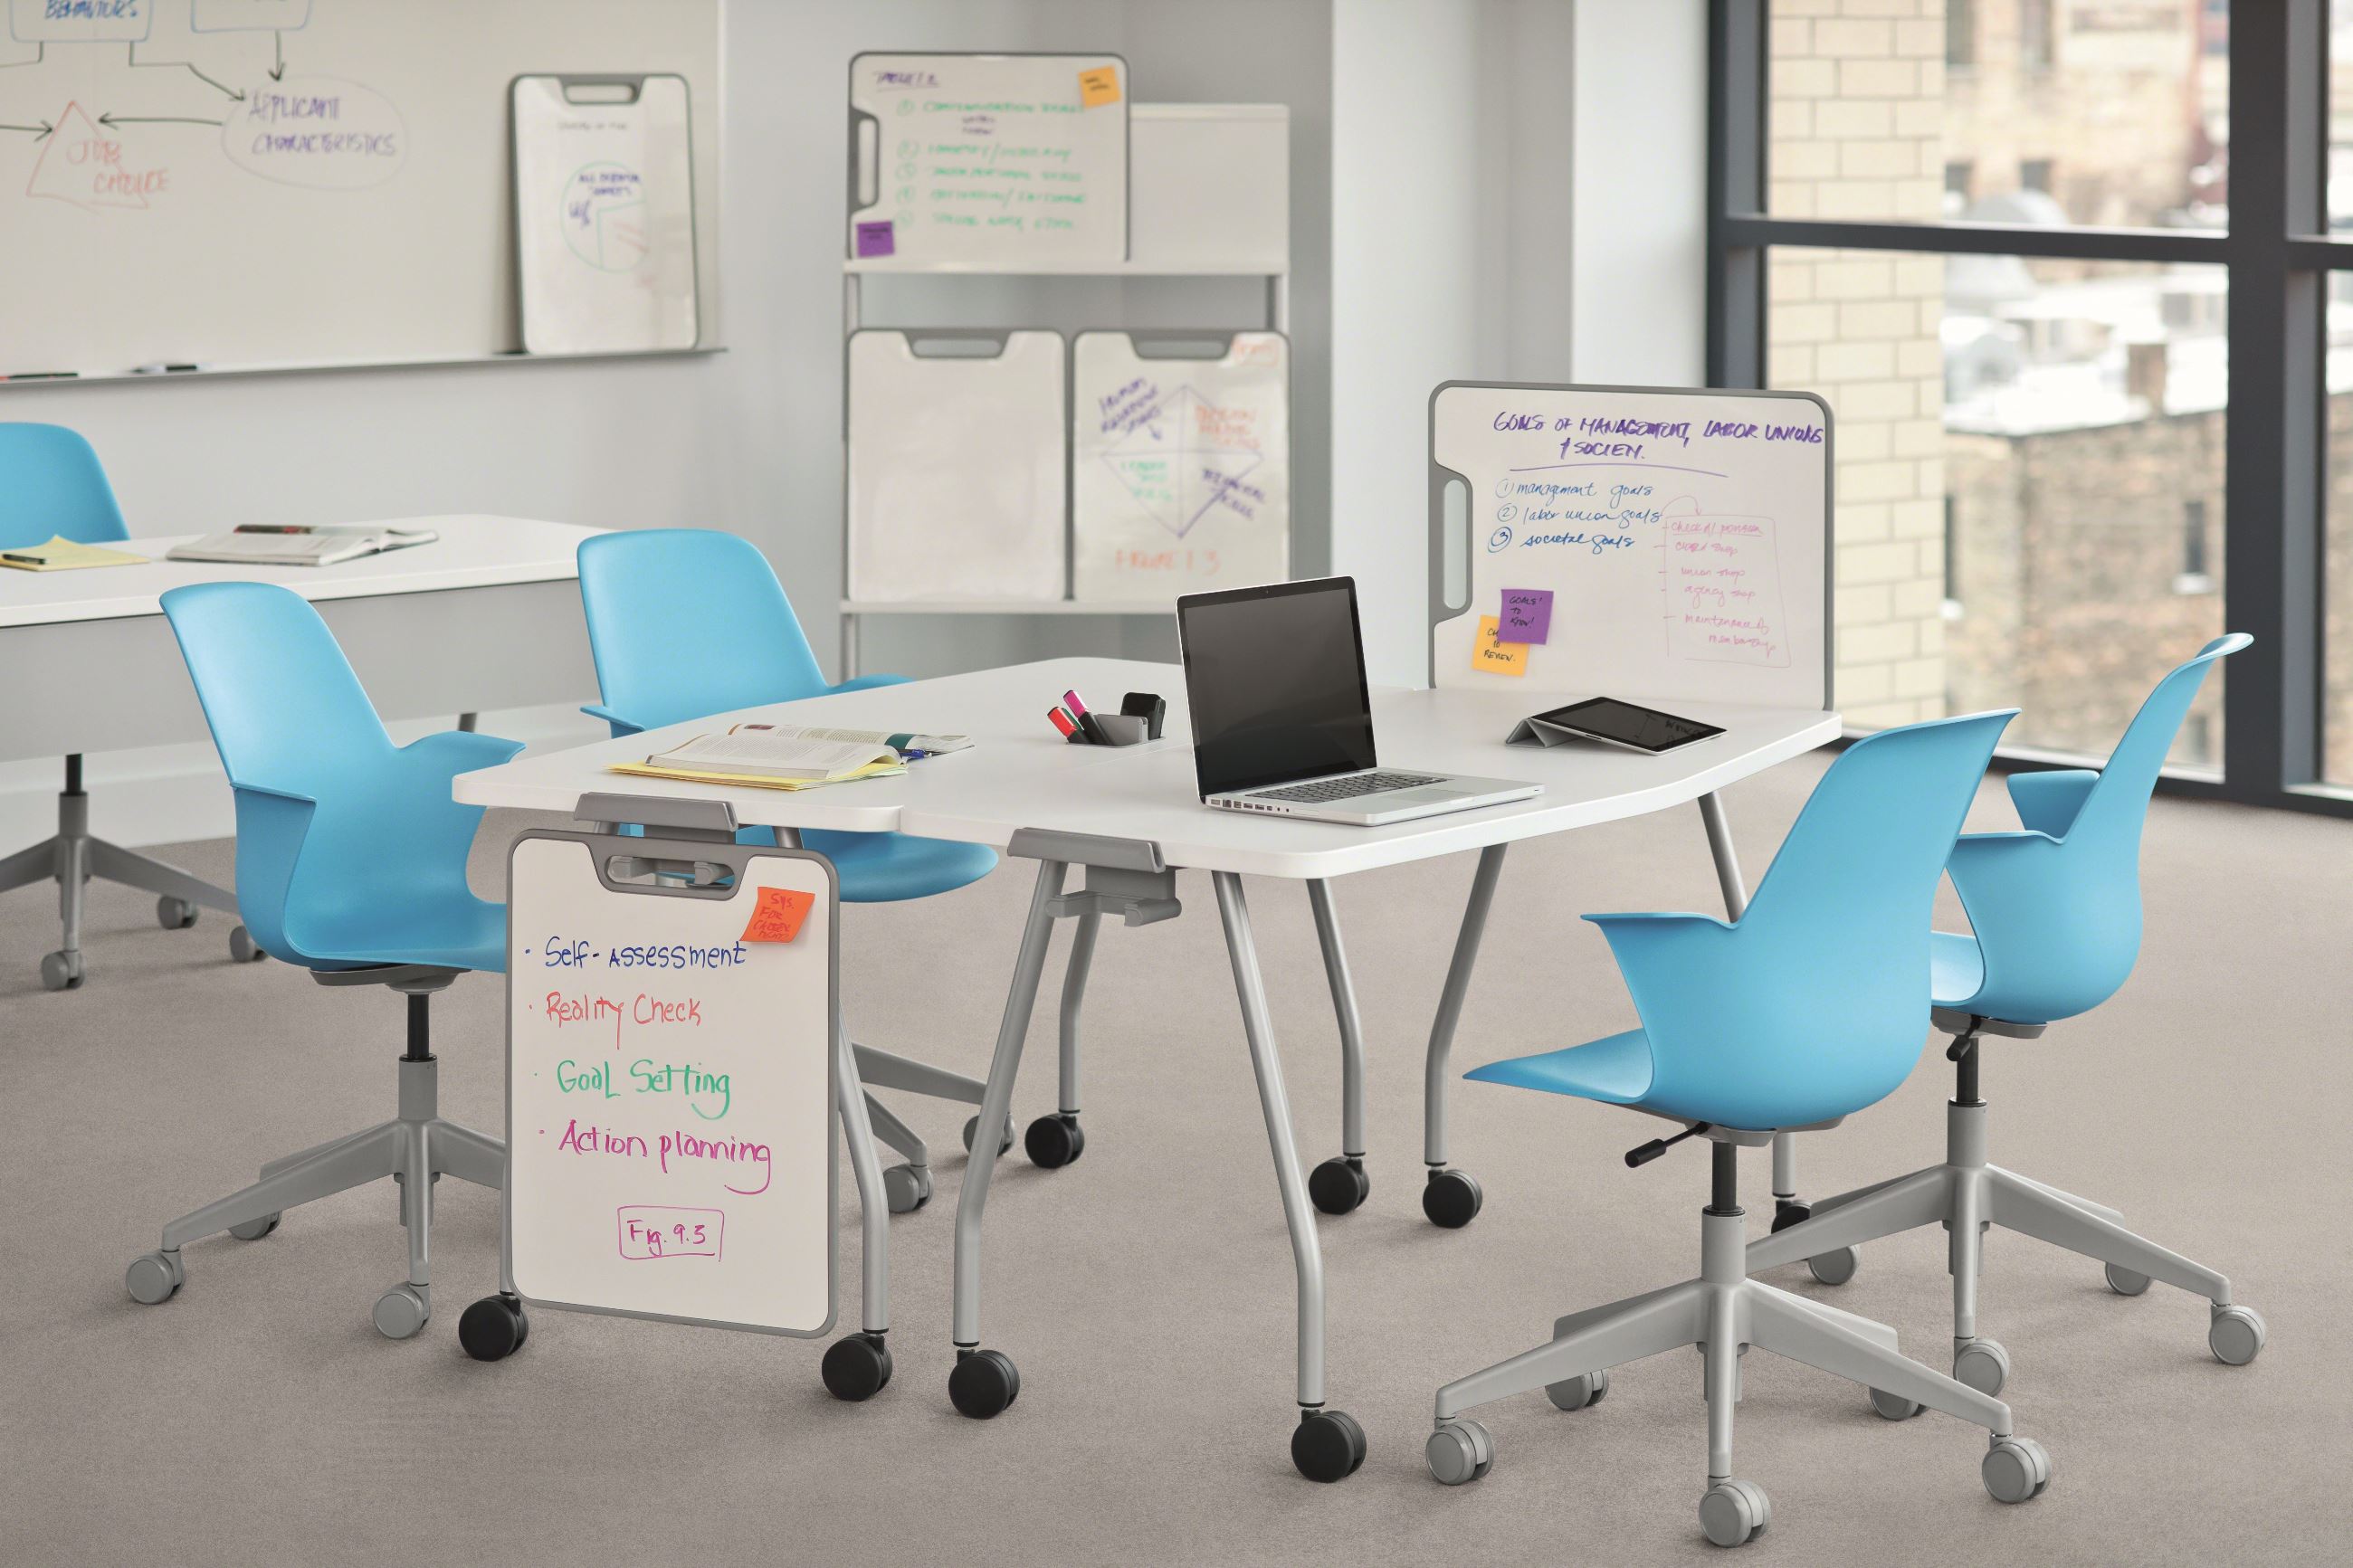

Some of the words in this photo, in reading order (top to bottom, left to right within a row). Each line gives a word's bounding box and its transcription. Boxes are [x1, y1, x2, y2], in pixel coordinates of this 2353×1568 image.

[1554, 417, 1574, 432] OF
[1517, 482, 1597, 507] management
[1609, 484, 1654, 509] goals
[1522, 508, 1560, 525] labor
[1565, 509, 1616, 521] union
[1618, 509, 1662, 529] goals
[1519, 532, 1590, 548] societal
[1591, 534, 1635, 555] goals
[546, 991, 624, 1050] Reality
[634, 993, 702, 1027] Check
[558, 1118, 648, 1158] Action
[658, 1130, 772, 1196] planning
[626, 1219, 668, 1256] Fig.
[672, 1222, 706, 1246] 9.3
